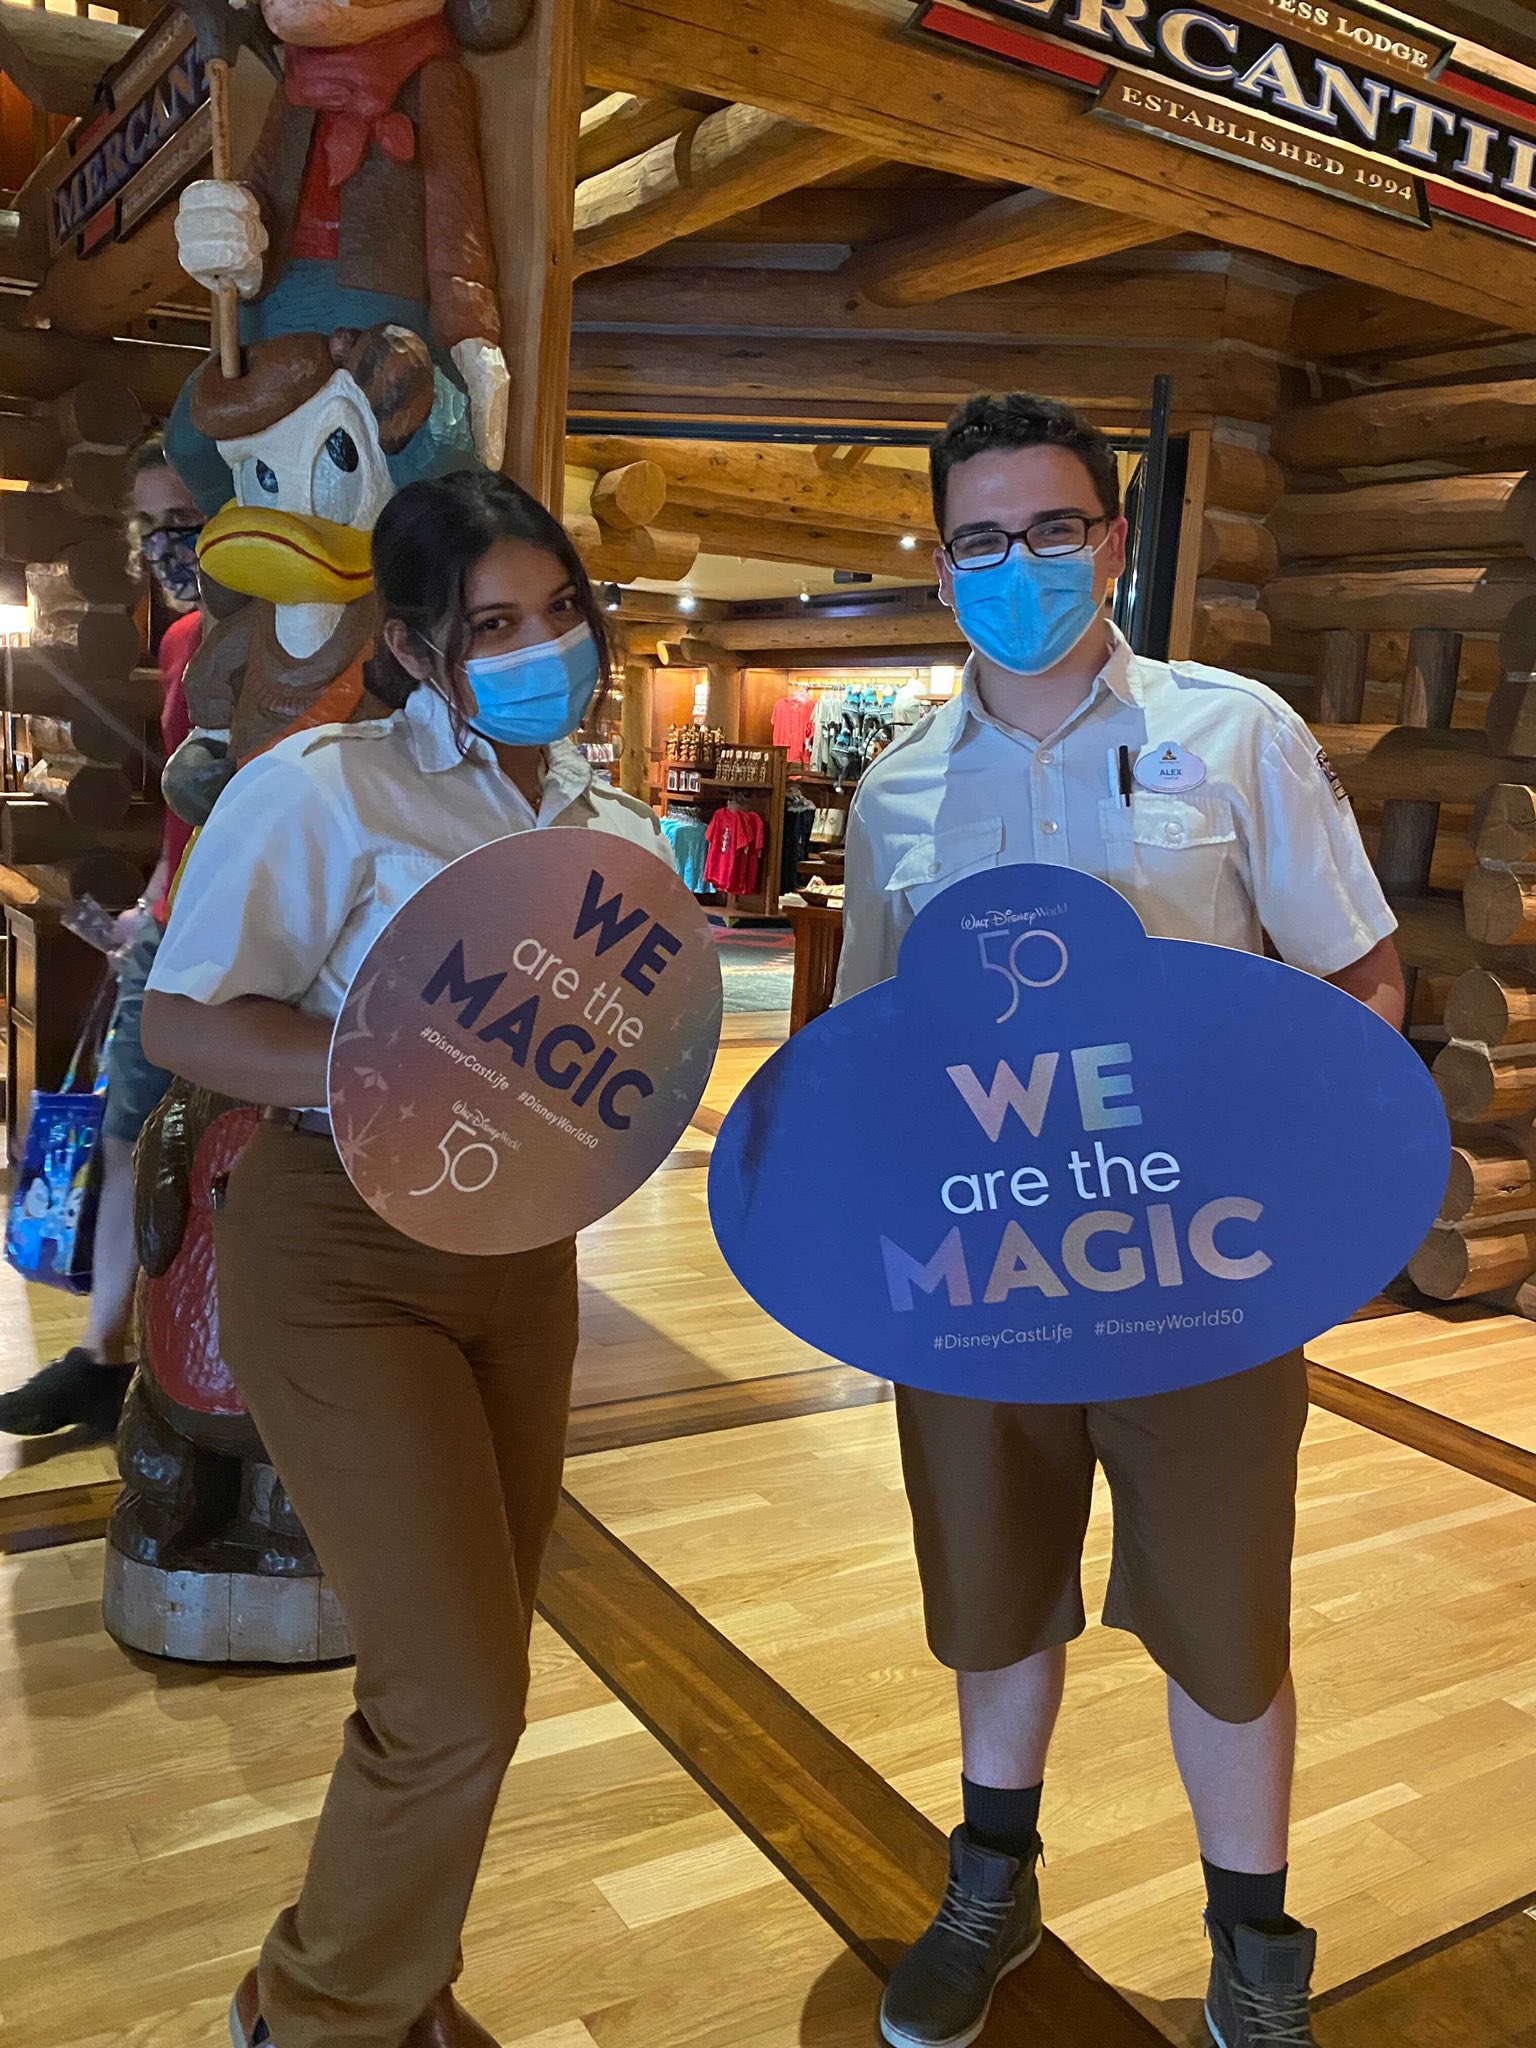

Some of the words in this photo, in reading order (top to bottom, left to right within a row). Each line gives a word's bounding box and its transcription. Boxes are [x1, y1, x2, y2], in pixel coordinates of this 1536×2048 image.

[1268, 0, 1329, 26] ESS
[1336, 16, 1429, 69] LODGE
[1121, 85, 1345, 176] ESTABLISHED
[1354, 168, 1412, 201] 1994
[573, 868, 683, 997] WE
[977, 929, 1069, 1024] 50
[420, 938, 655, 1131] MAGIC
[512, 937, 581, 1000] are
[583, 981, 644, 1049] the
[420, 1026, 510, 1092] #DisneyCastLife
[516, 1091, 600, 1149] #DisneyWorld50
[945, 1042, 1143, 1143] WE
[408, 1119, 499, 1196] 50
[940, 1165, 1050, 1215] are
[1067, 1140, 1181, 1200] the
[880, 1196, 1273, 1313] MAGIC
[933, 1323, 1073, 1351] #DisneyCastLife
[1094, 1308, 1244, 1337] #DisneyWorld50
